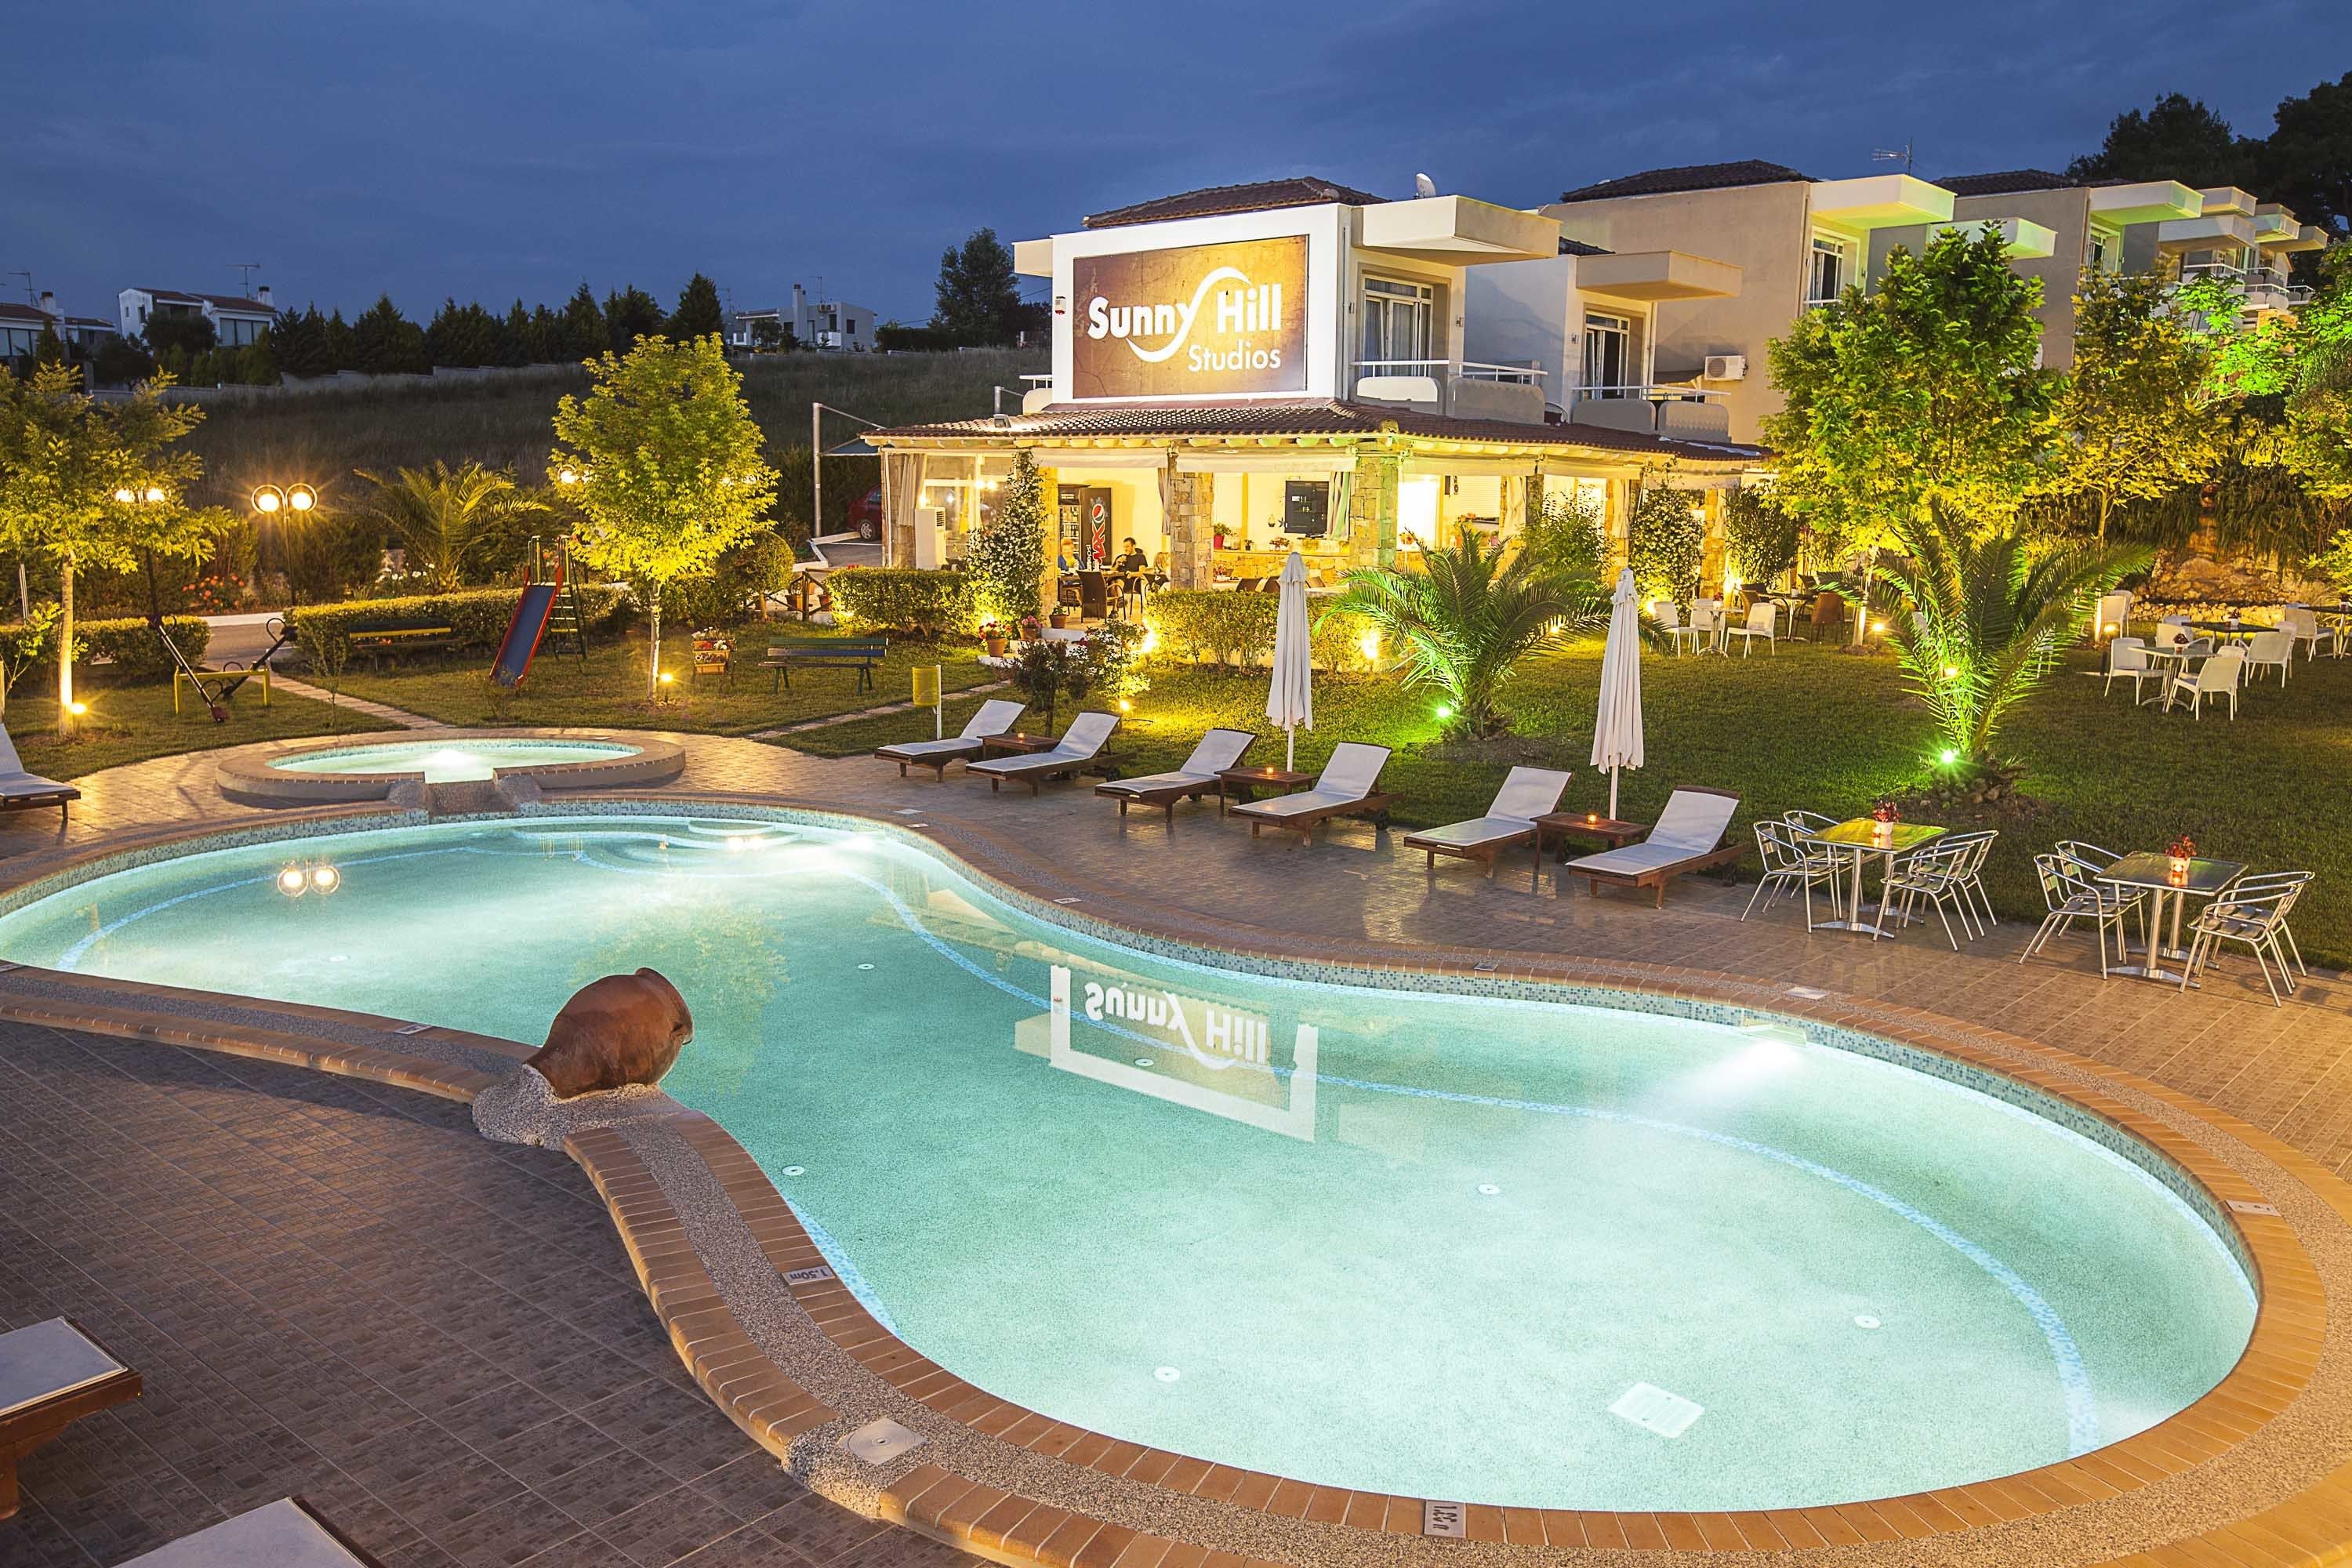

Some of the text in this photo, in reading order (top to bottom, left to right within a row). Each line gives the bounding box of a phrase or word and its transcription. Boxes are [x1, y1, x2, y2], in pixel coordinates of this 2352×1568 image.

[1087, 283, 1282, 362] Sunny Hill
[1188, 339, 1281, 372] Studios
[789, 1269, 829, 1279] 1.50m
